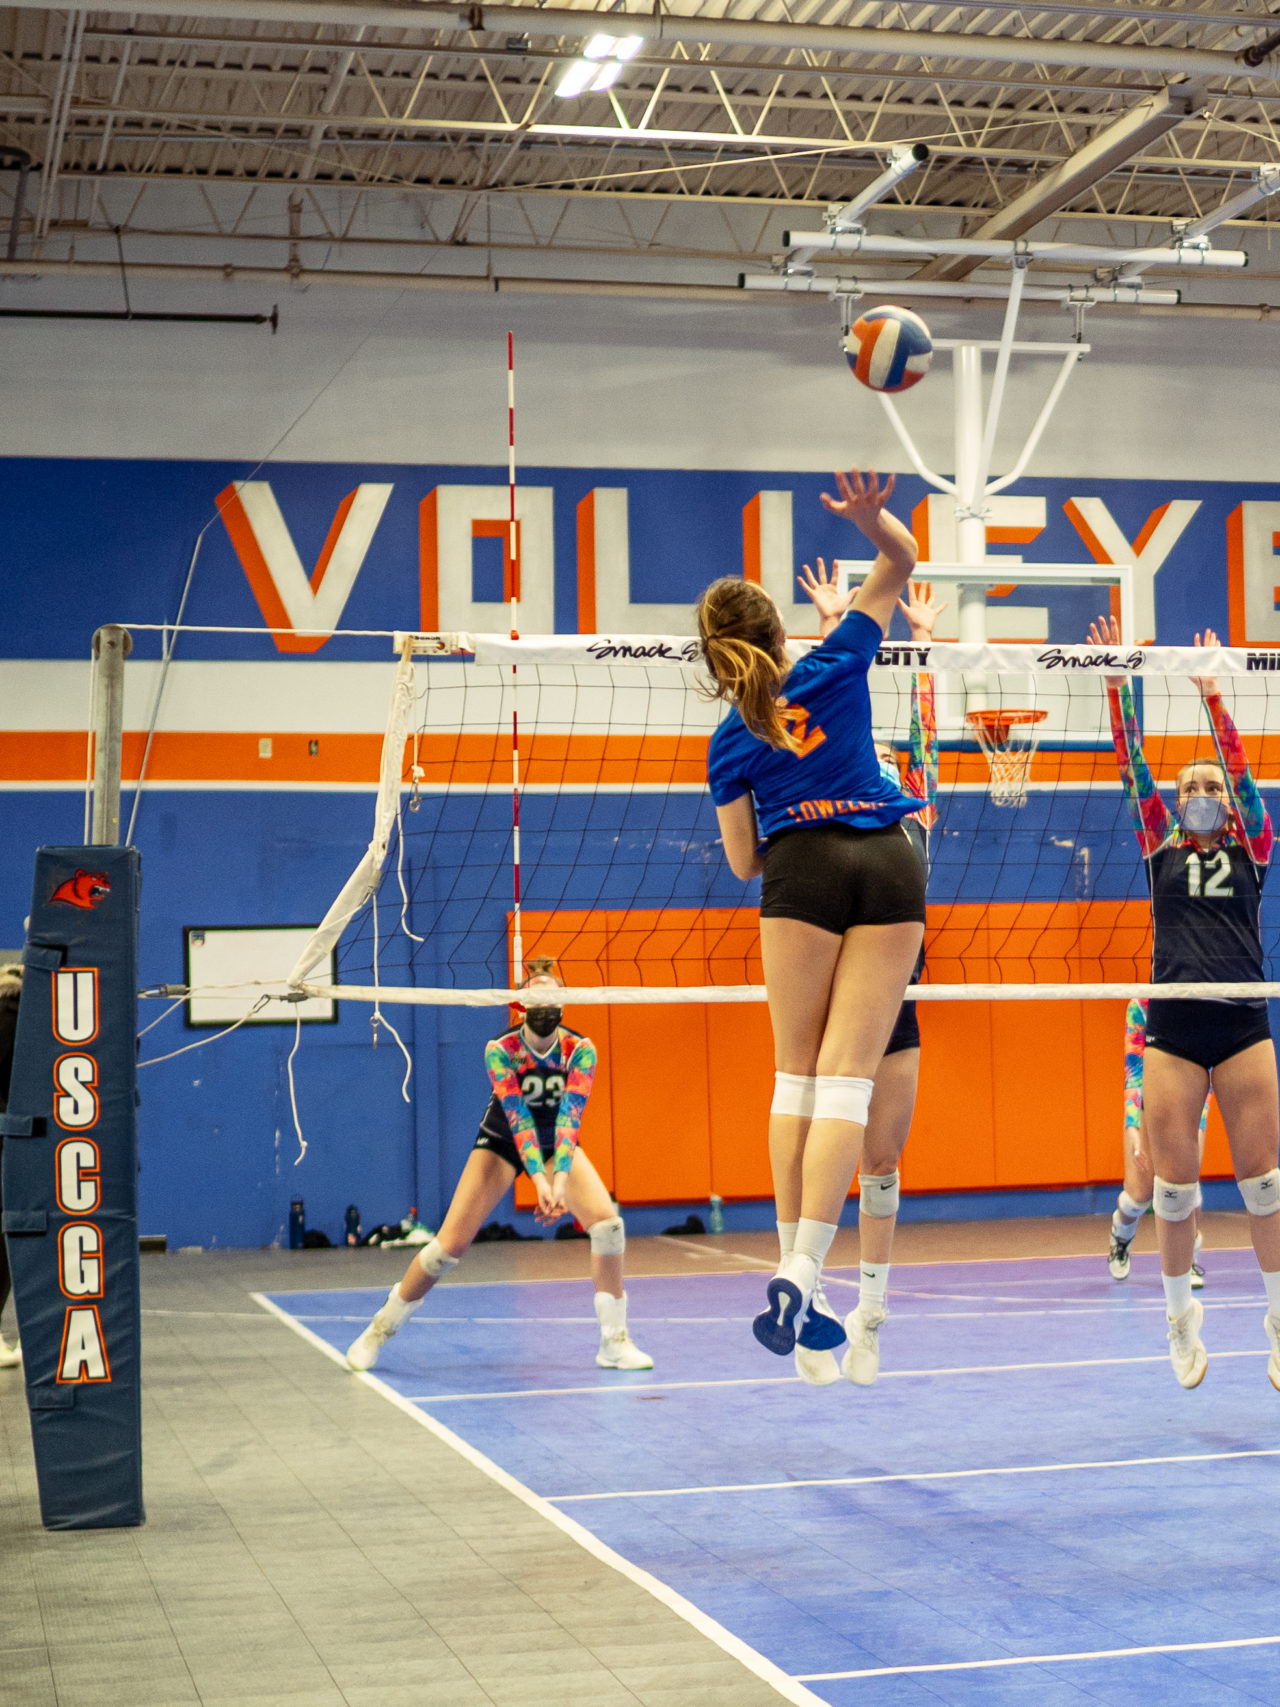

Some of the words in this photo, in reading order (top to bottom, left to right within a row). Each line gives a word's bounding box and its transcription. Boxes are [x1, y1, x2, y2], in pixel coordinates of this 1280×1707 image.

[875, 646, 931, 666] CITY
[1185, 850, 1234, 897] 12
[521, 1075, 565, 1106] 23
[52, 967, 111, 1382] USCGA
